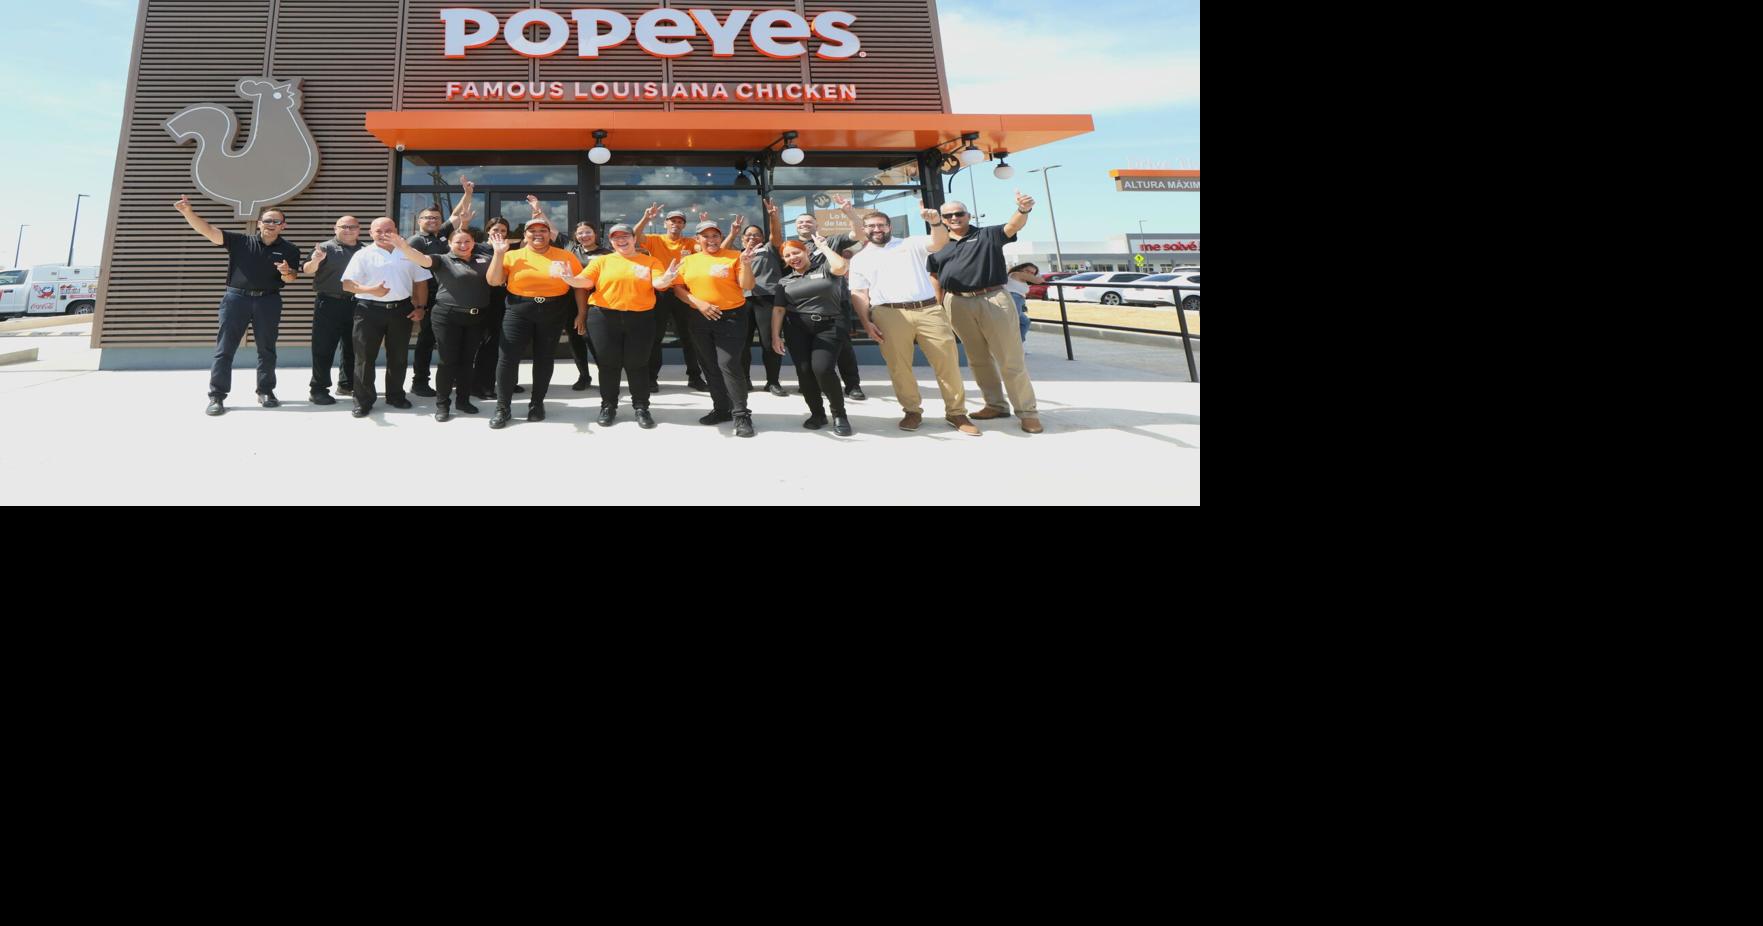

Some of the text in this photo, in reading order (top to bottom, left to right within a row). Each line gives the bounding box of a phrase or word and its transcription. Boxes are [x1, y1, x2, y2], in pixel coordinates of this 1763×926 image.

[446, 81, 857, 102] FAMOUS LOUISIANA CHICKEN
[1124, 181, 1165, 189] ALTURA
